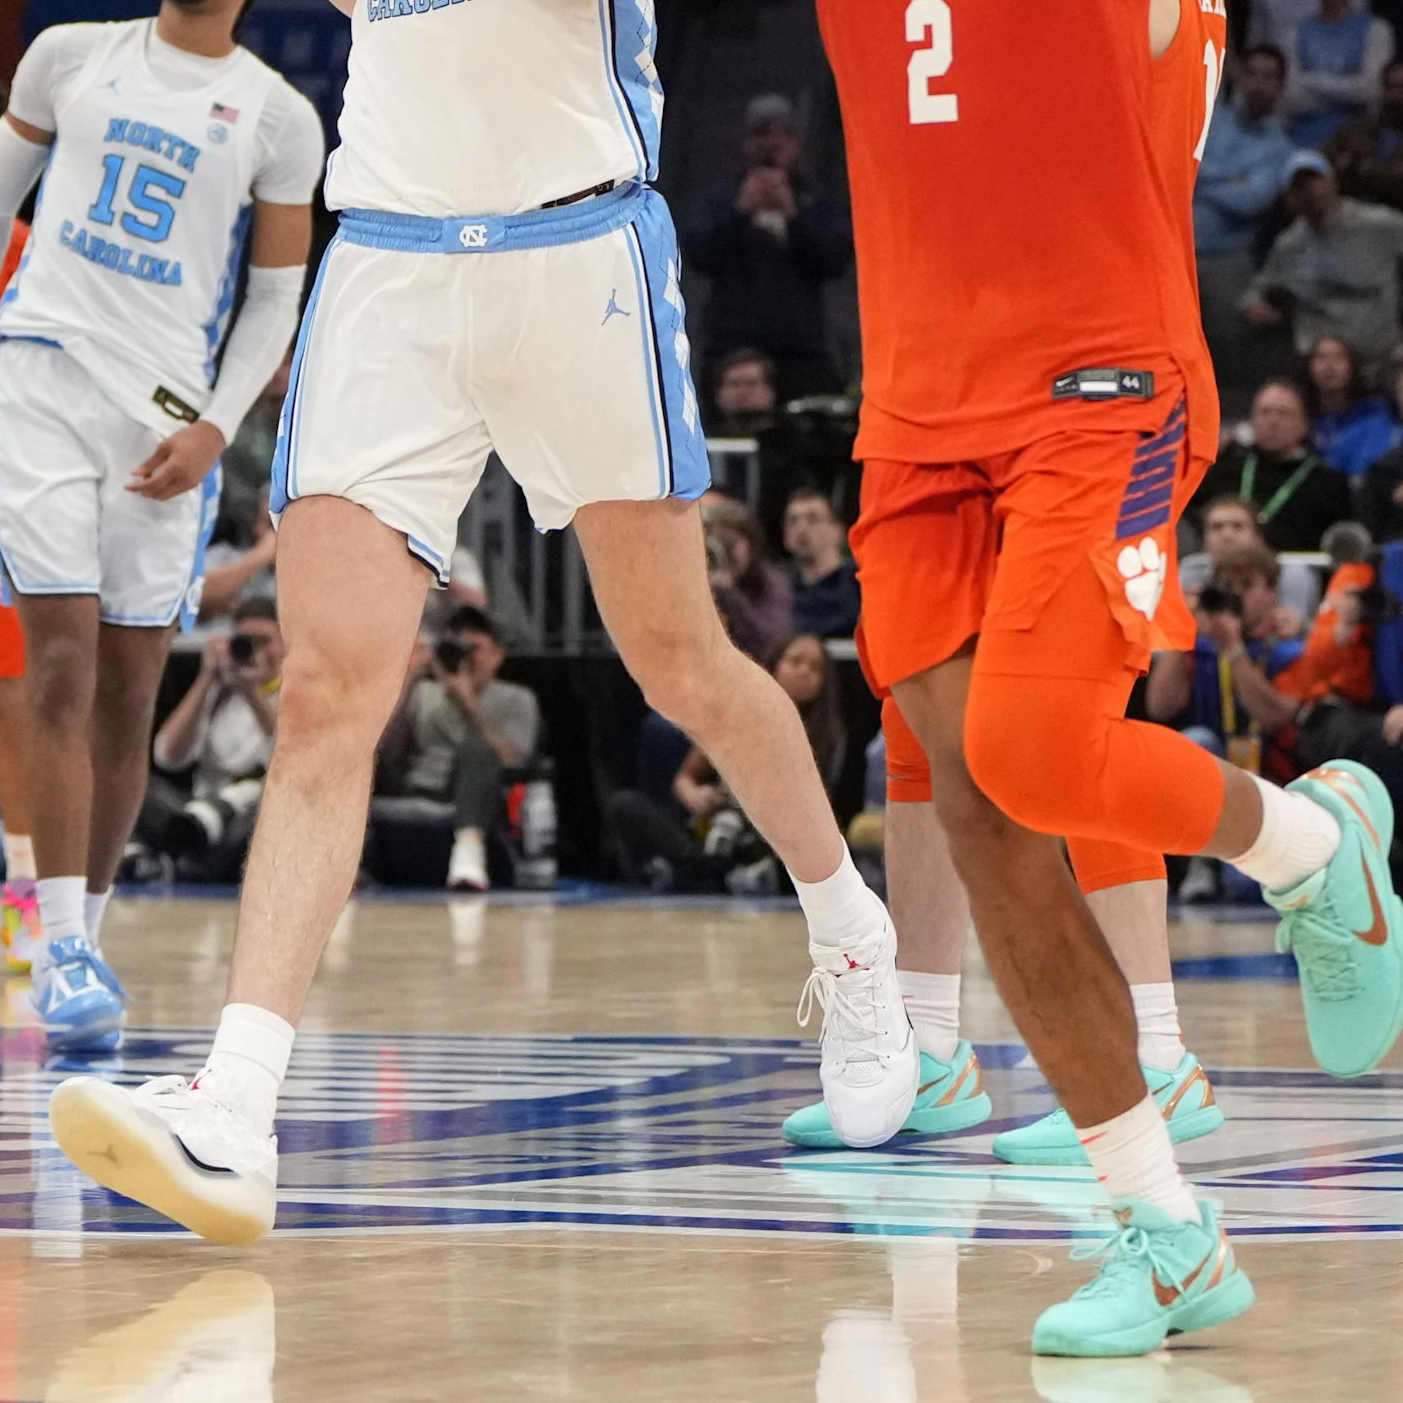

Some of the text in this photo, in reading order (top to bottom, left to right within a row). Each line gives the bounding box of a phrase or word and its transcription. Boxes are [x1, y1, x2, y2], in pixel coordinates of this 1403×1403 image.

[103, 117, 202, 174] NORTH
[87, 153, 187, 244] 15
[59, 219, 183, 287] CAROLINA
